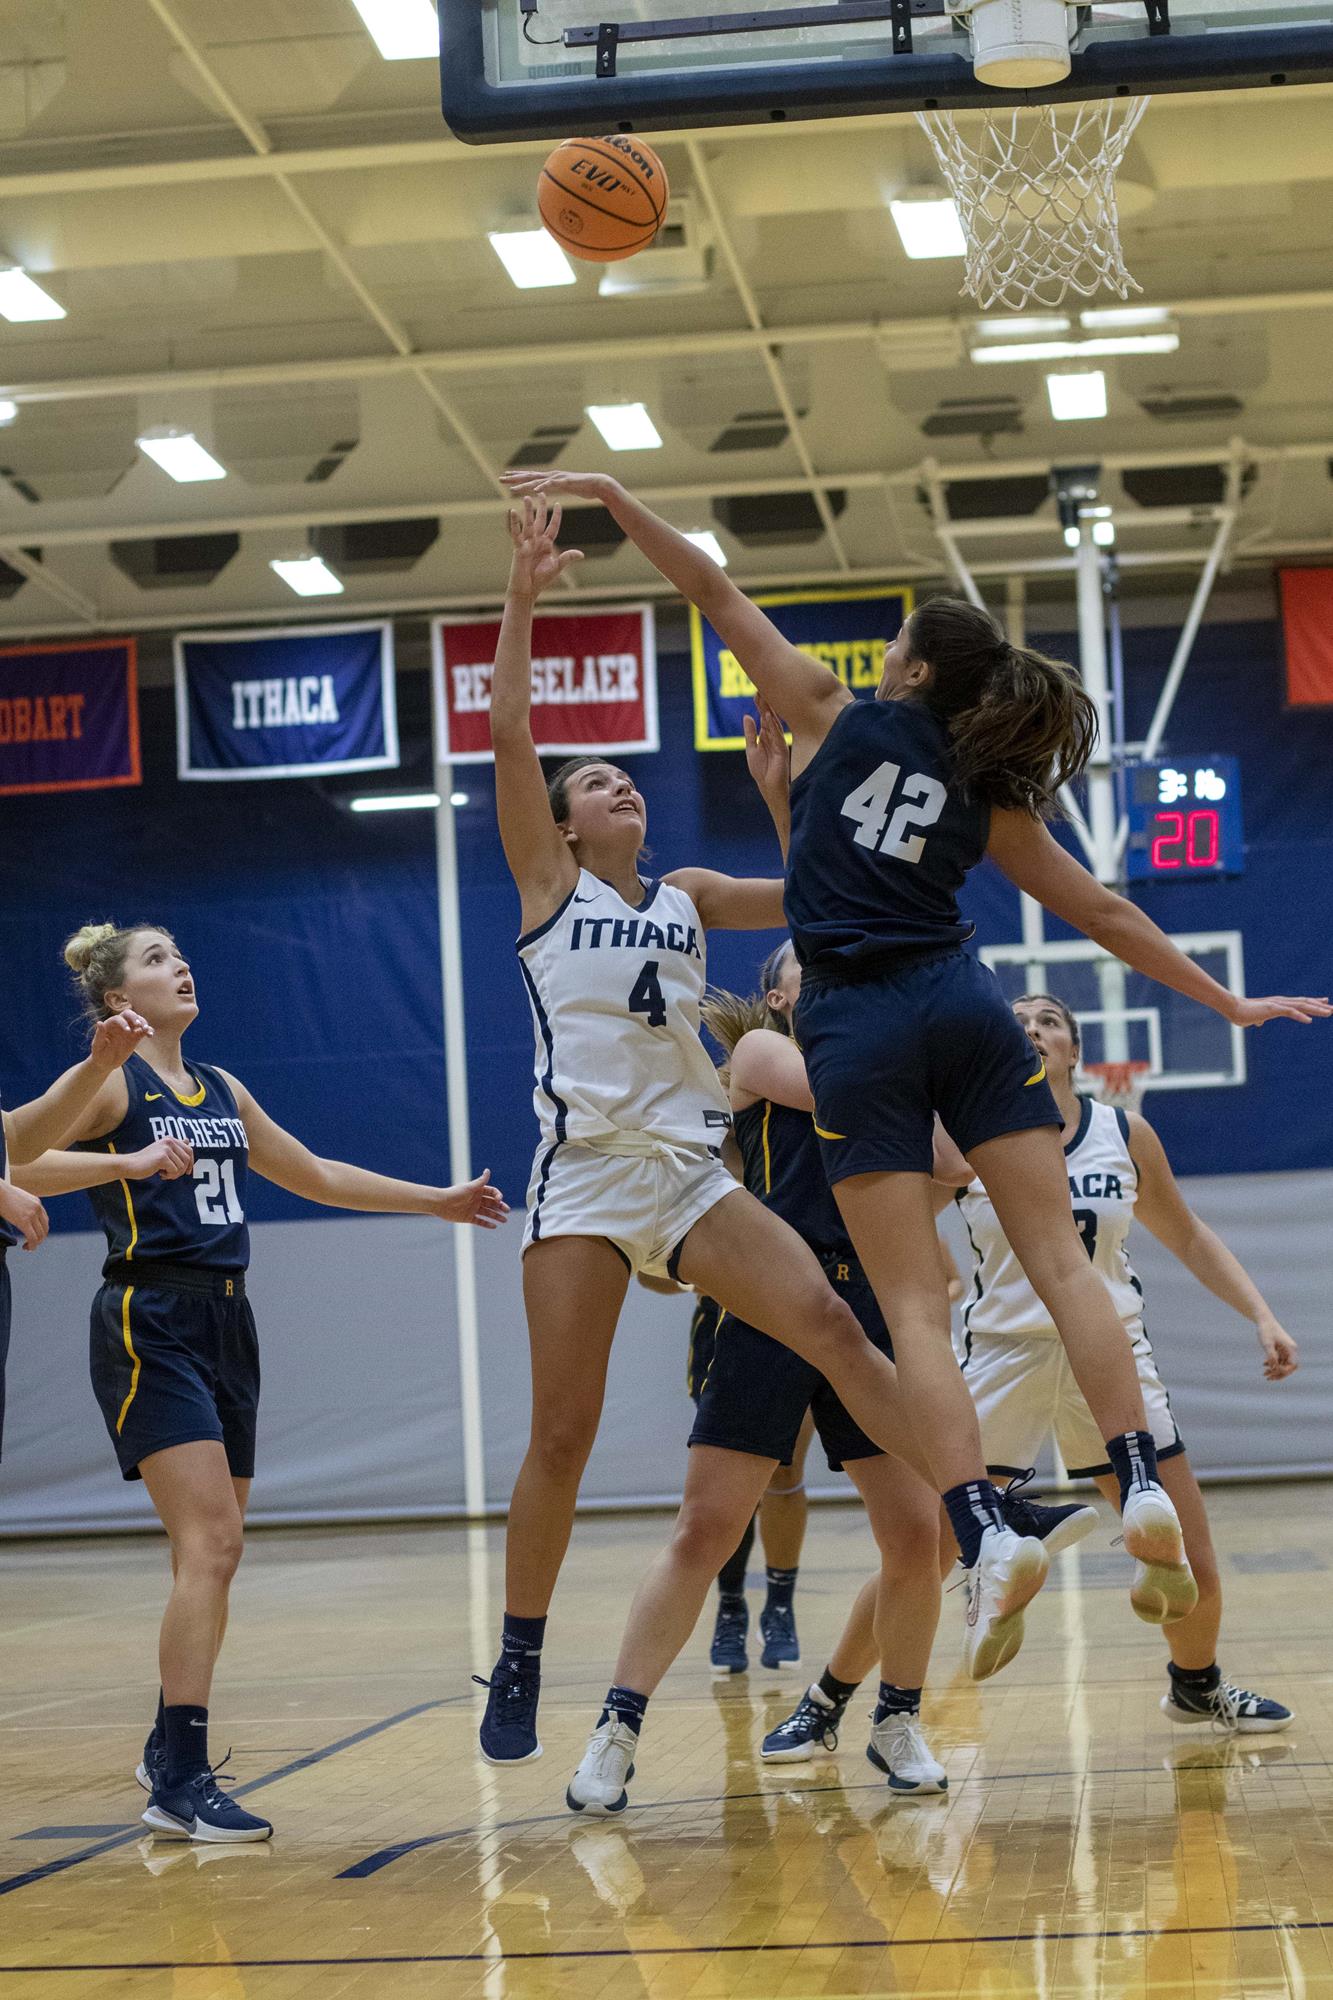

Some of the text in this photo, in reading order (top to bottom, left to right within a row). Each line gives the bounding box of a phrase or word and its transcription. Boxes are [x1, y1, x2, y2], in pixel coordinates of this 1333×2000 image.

[232, 674, 339, 730] ITHACA
[452, 653, 639, 713] RESELAER
[0, 694, 85, 744] OBART
[840, 761, 948, 864] 42
[1151, 809, 1219, 869] 20
[570, 917, 702, 960] ITHACA
[628, 960, 667, 1027] 4
[193, 1158, 244, 1225] 21
[1068, 1172, 1123, 1200] ACA
[226, 1279, 234, 1296] R
[837, 1263, 850, 1281] R
